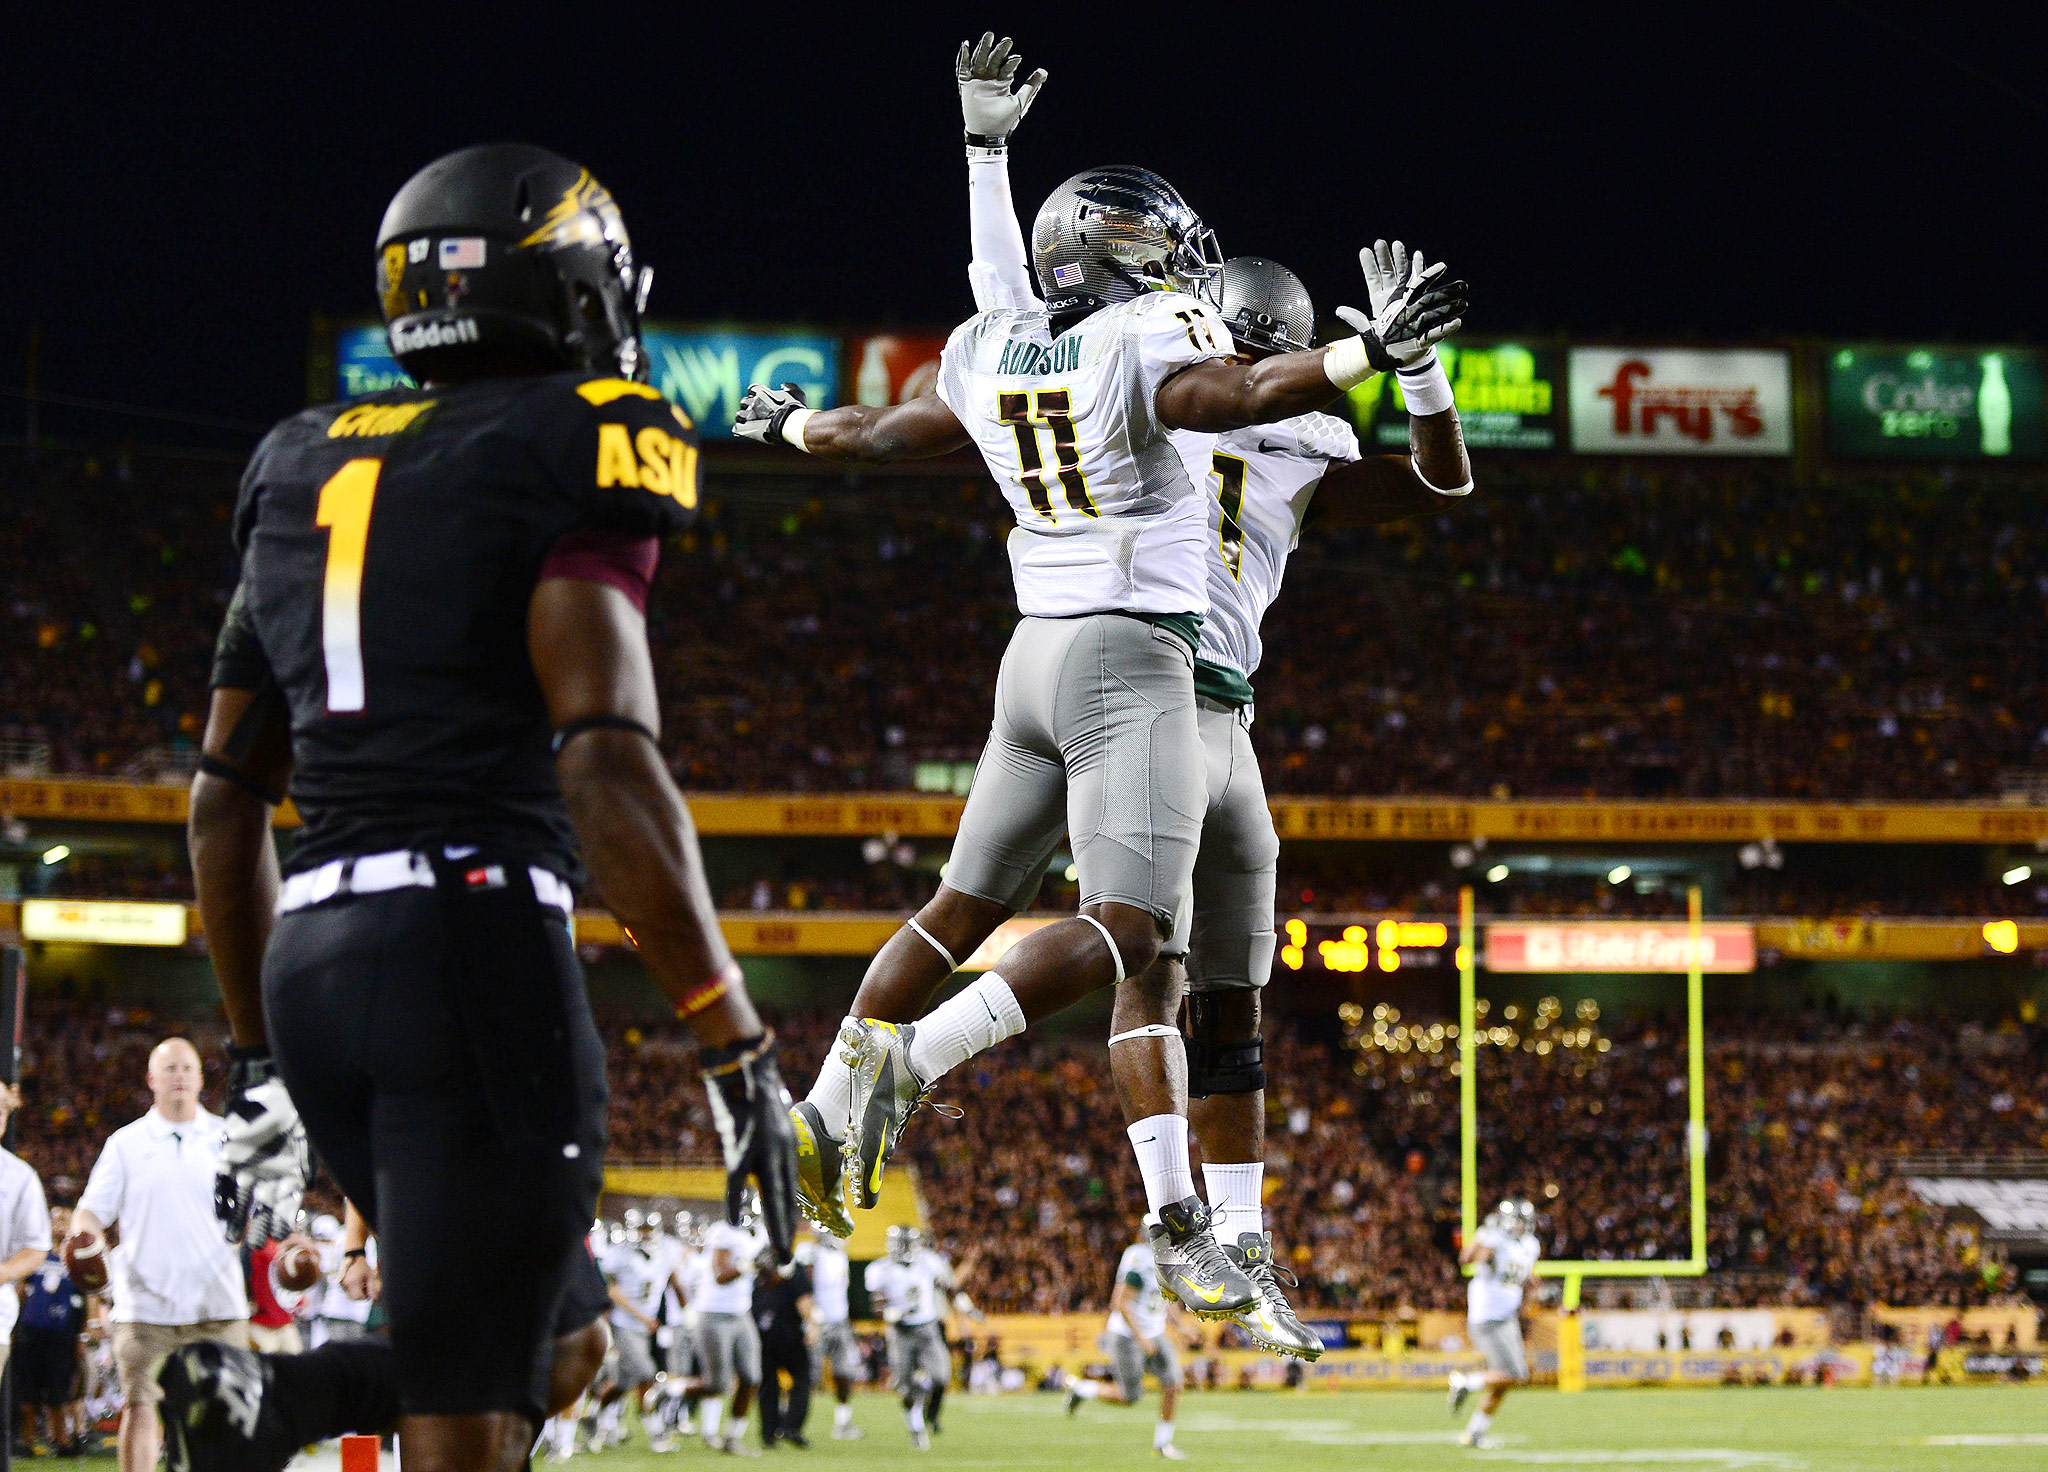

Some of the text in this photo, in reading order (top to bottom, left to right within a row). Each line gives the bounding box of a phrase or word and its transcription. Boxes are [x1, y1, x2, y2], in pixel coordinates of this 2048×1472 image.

[1174, 308, 1218, 353] 11
[597, 423, 699, 509] ASU
[997, 387, 1101, 528] 11
[316, 457, 384, 713] 1
